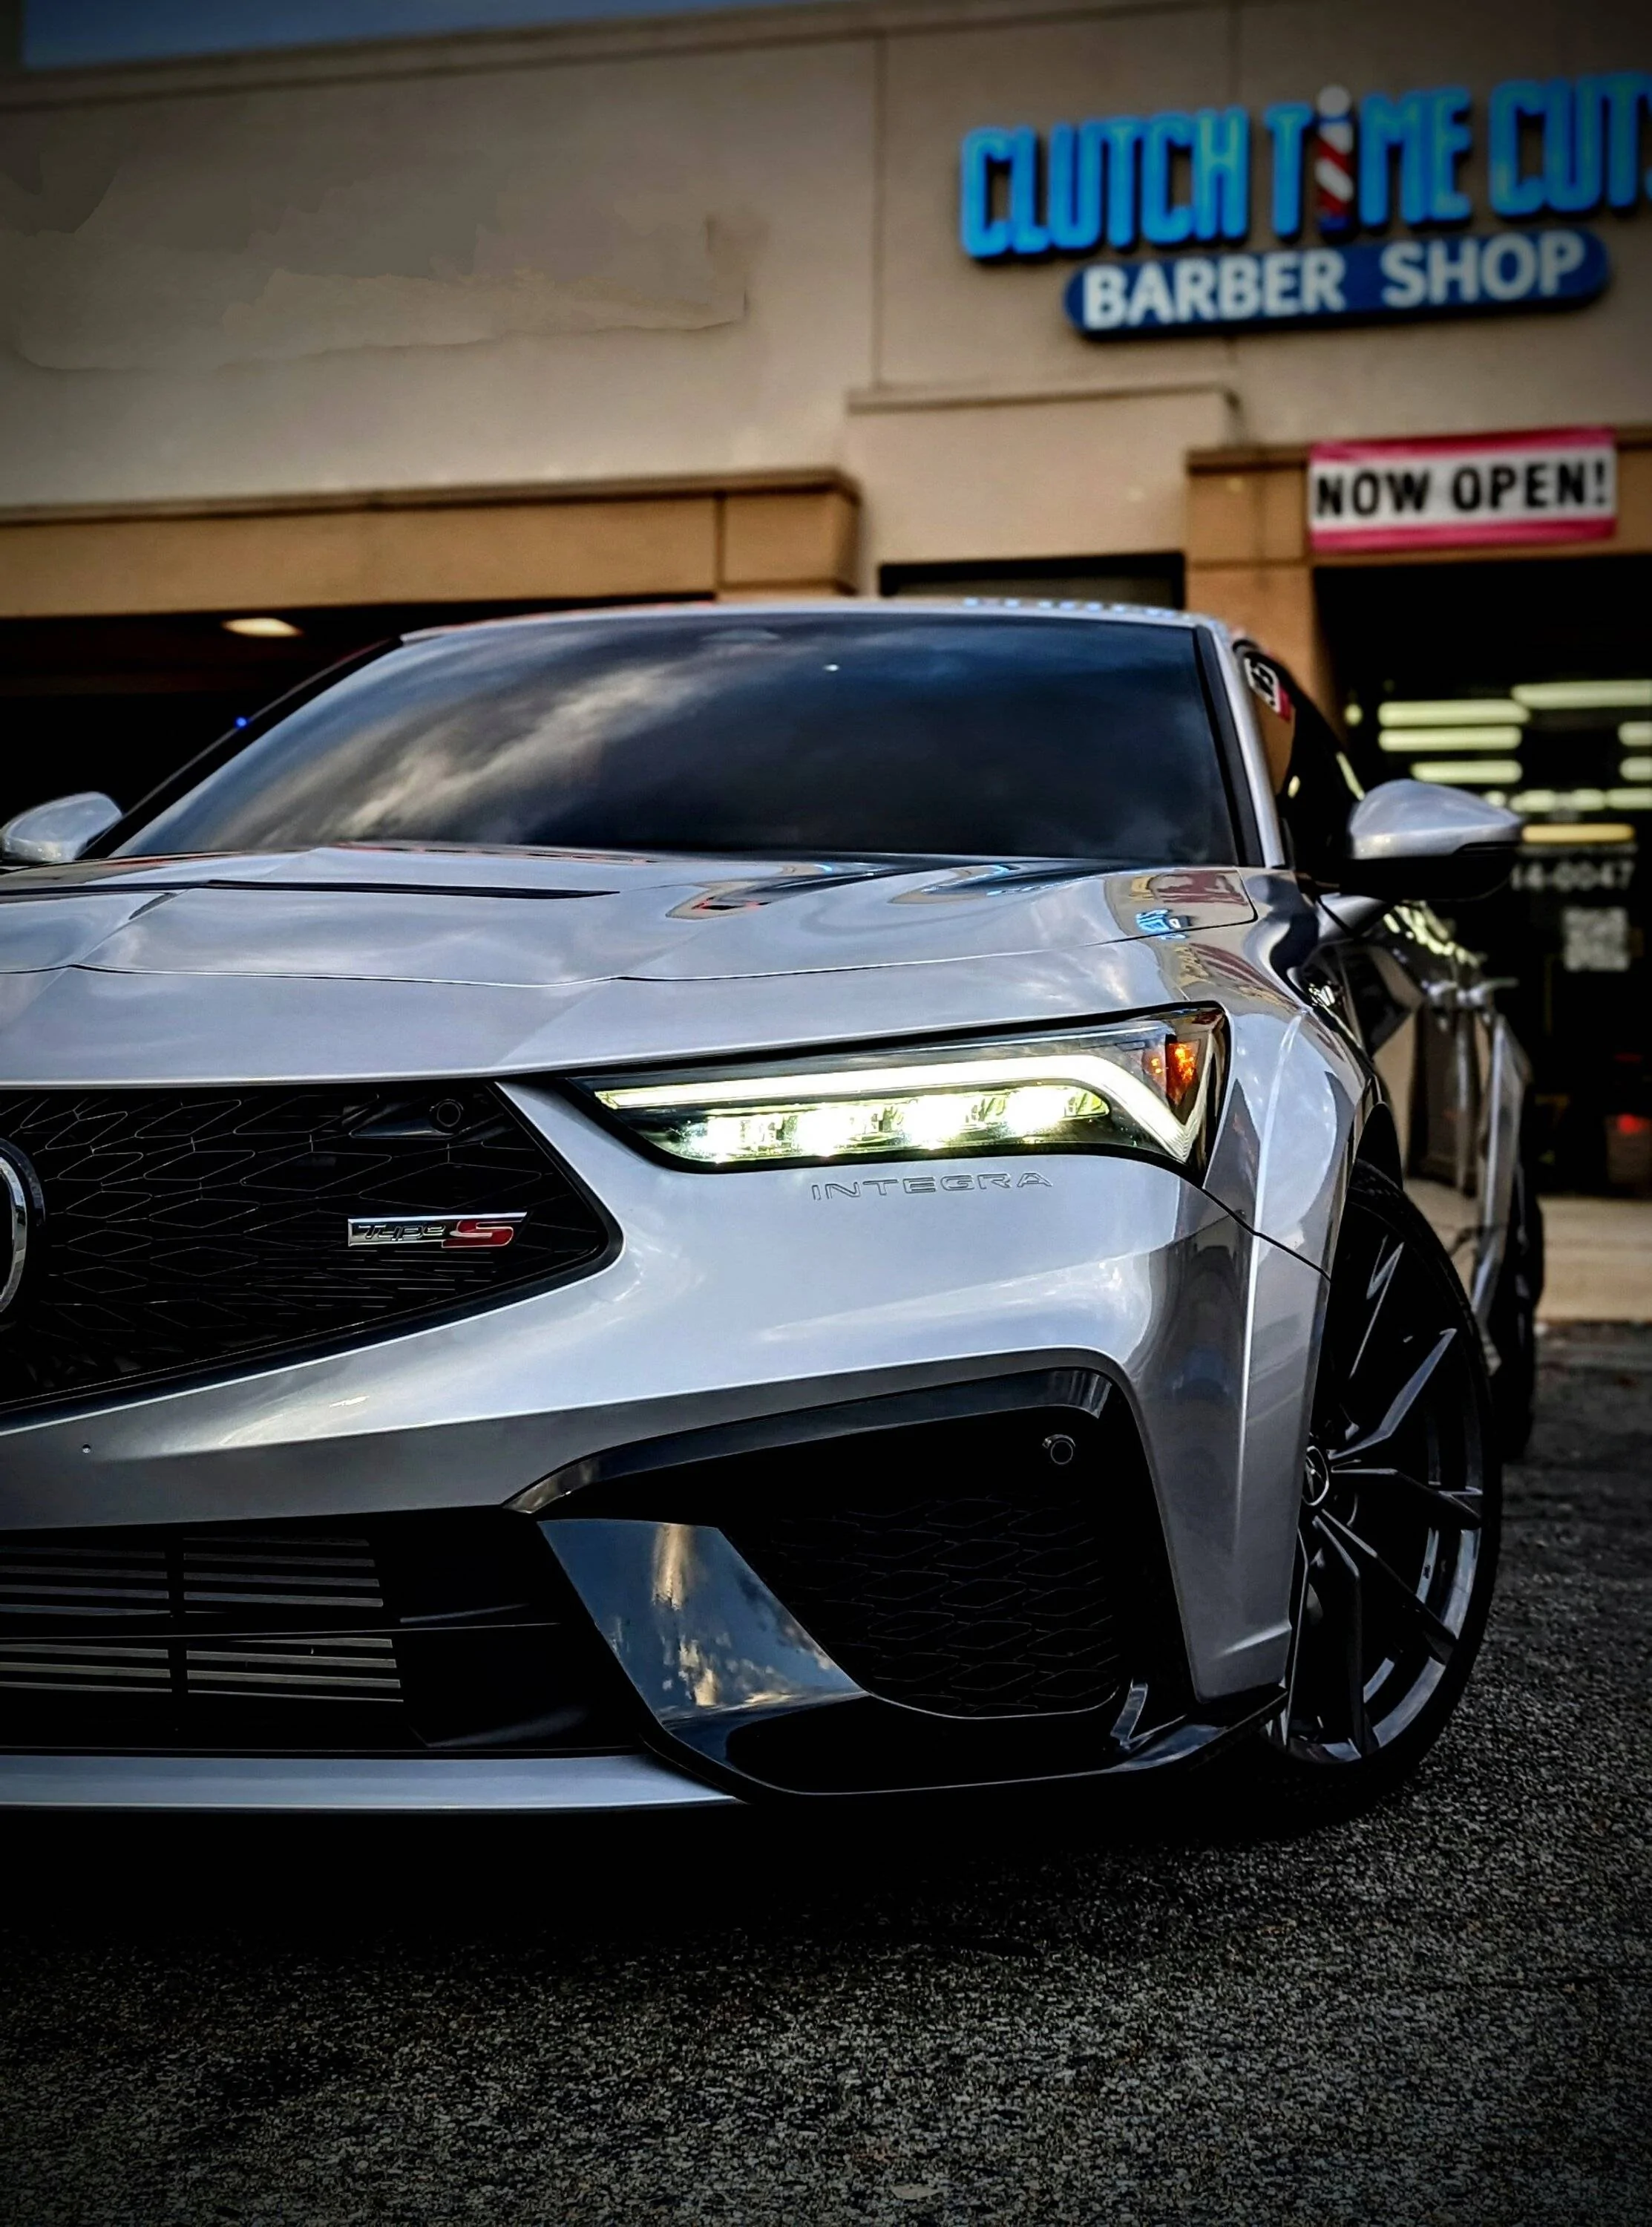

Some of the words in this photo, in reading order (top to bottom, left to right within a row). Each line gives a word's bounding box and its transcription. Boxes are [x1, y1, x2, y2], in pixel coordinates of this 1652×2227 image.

[961, 107, 1250, 260] CLUTCH
[1488, 72, 1652, 217] CUT
[1082, 252, 1348, 331] BARBER
[1382, 230, 1587, 310] SHOP
[1317, 468, 1429, 518] NOW
[1450, 457, 1607, 512] OPEN!
[811, 1171, 1053, 1200] INTEGRA
[358, 1224, 446, 1242] Type
[442, 1220, 514, 1249] S
